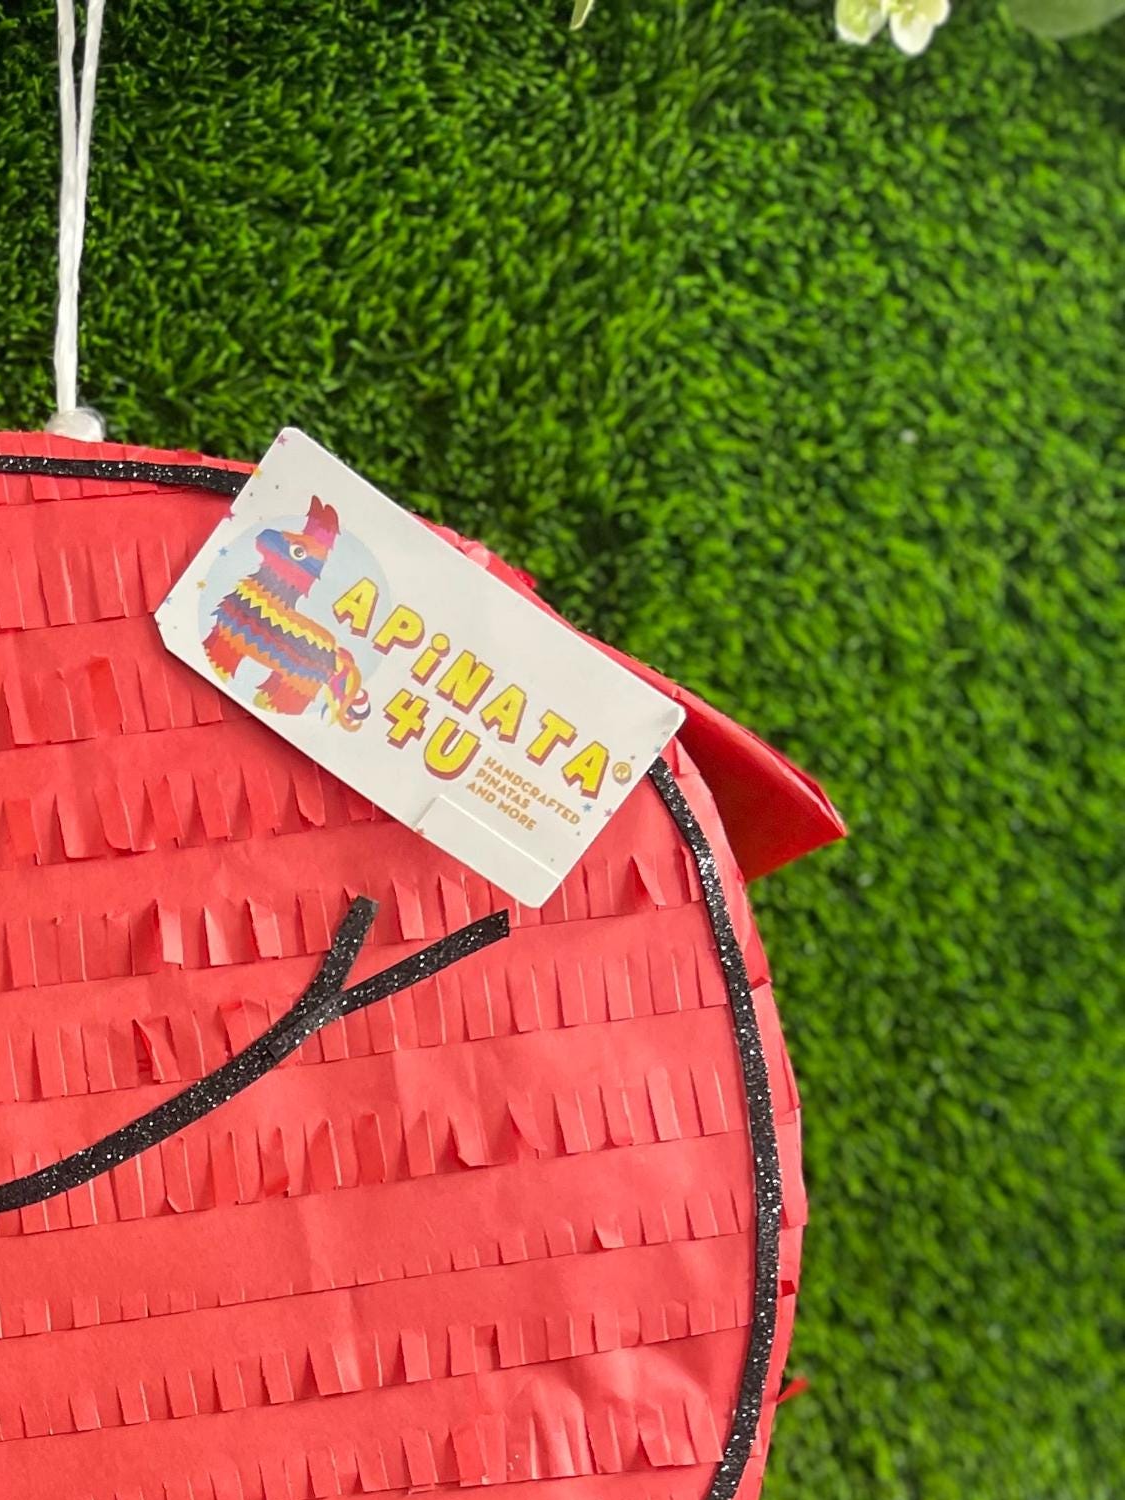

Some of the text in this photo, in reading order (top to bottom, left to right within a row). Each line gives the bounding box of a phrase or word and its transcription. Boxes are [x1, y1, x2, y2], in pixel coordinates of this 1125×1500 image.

[382, 687, 480, 780] 4U
[466, 782, 537, 831] AND MORE
[475, 767, 531, 810] PINATAS
[483, 756, 581, 825] HANDCRAFTED
